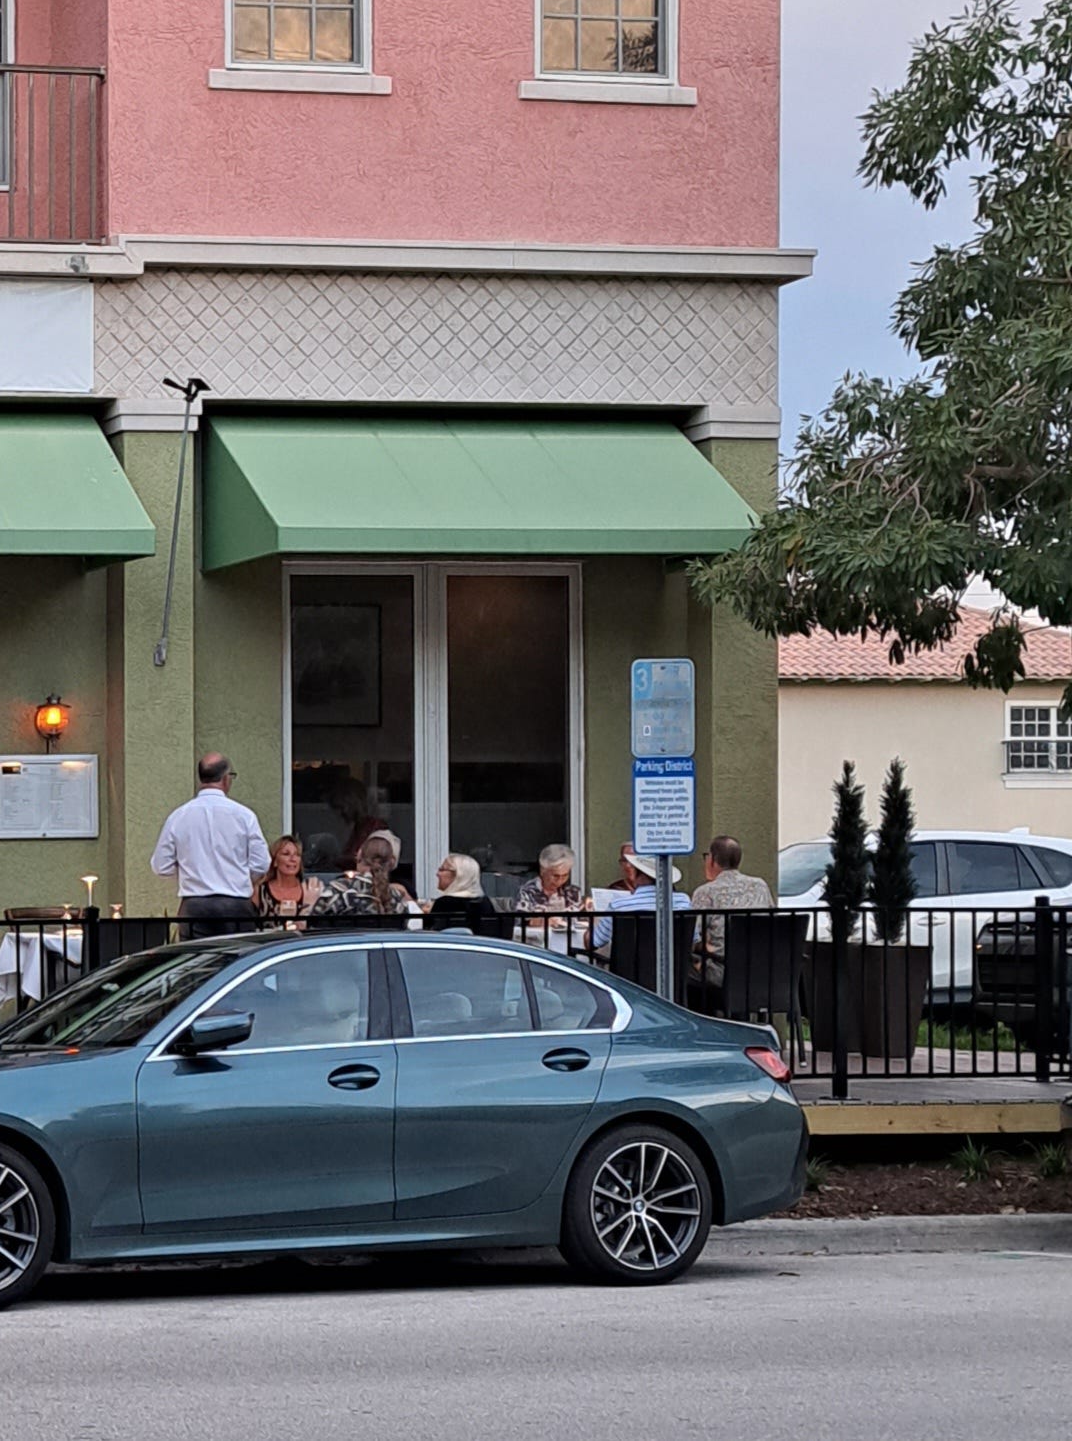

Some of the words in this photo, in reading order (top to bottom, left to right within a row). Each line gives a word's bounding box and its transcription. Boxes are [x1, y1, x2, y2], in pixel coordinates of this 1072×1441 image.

[636, 668, 648, 692] 3
[635, 760, 664, 774] Parking
[665, 760, 693, 772] District
